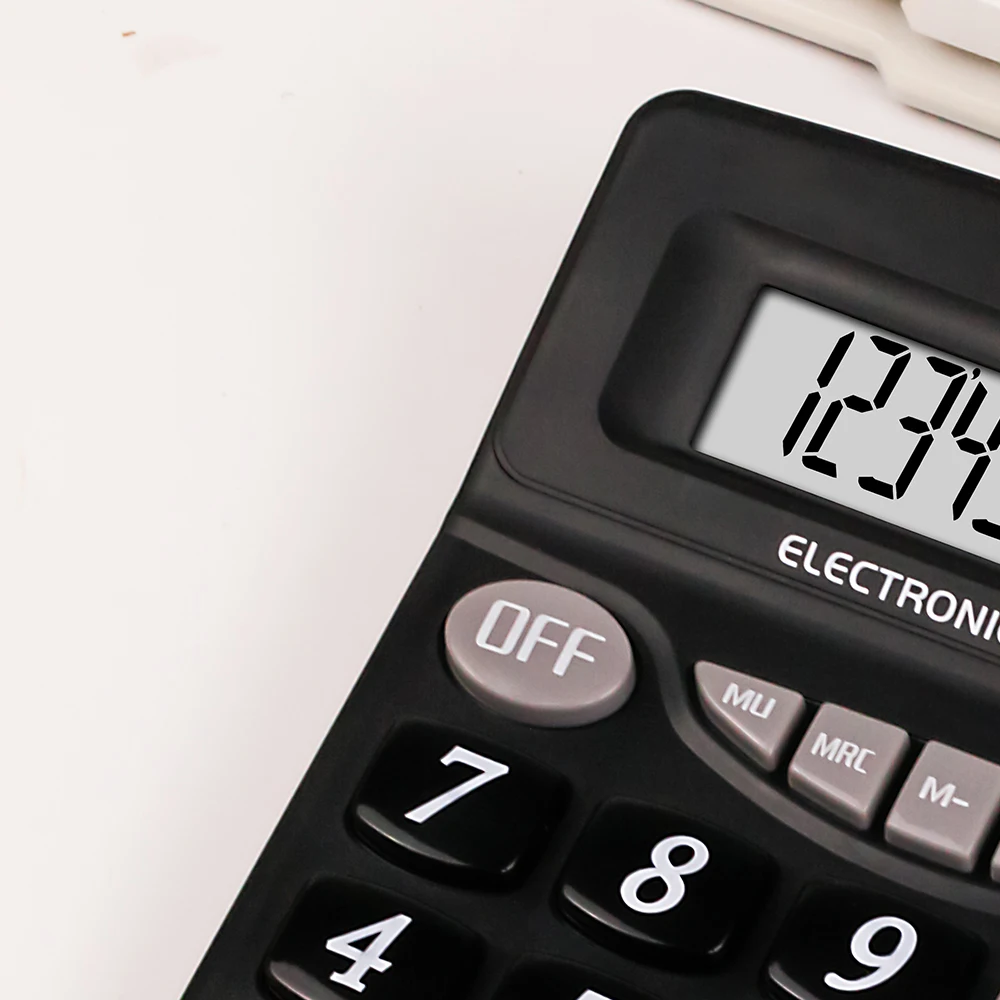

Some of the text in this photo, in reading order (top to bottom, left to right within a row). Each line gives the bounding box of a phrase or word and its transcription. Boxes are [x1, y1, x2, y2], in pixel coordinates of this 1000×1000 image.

[472, 598, 608, 679] OFF
[721, 681, 776, 721] MU
[404, 745, 510, 824] 7
[810, 731, 877, 776] MRC
[620, 835, 710, 914] 8
[325, 914, 413, 993] 4
[824, 916, 918, 991] 9
